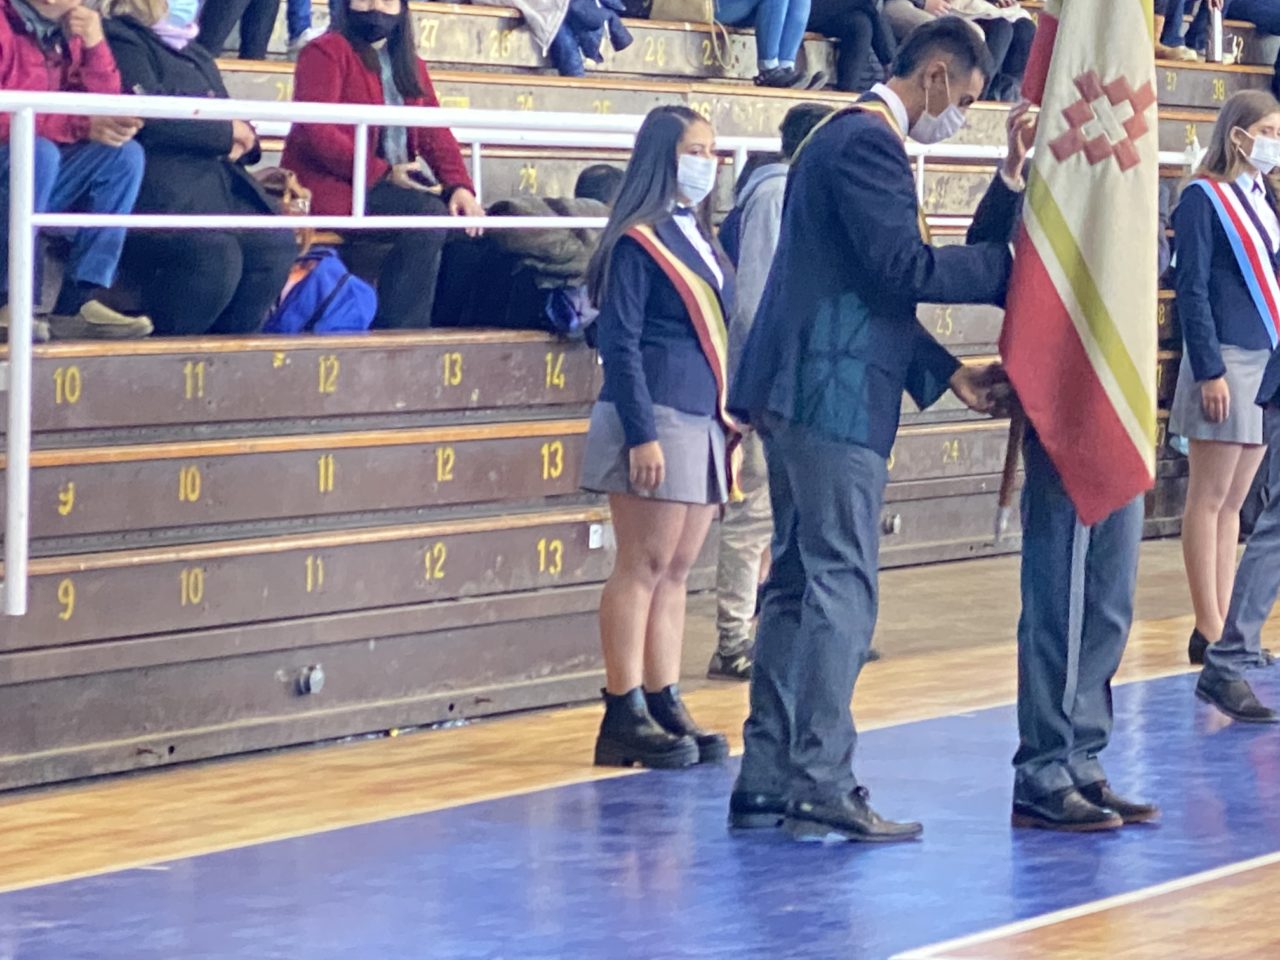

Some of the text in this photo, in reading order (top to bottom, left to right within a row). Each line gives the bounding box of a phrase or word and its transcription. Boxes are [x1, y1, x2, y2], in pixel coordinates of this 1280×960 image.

[419, 17, 439, 49] 27
[645, 35, 667, 68] 28
[935, 307, 953, 336] 25
[53, 352, 565, 404] 10 11 12 13 14
[179, 466, 201, 502] 10
[318, 455, 334, 492] 11
[436, 447, 456, 482] 12
[541, 441, 563, 479] 13
[943, 439, 961, 465] 24
[58, 538, 564, 620] 9 10 11 12 13
